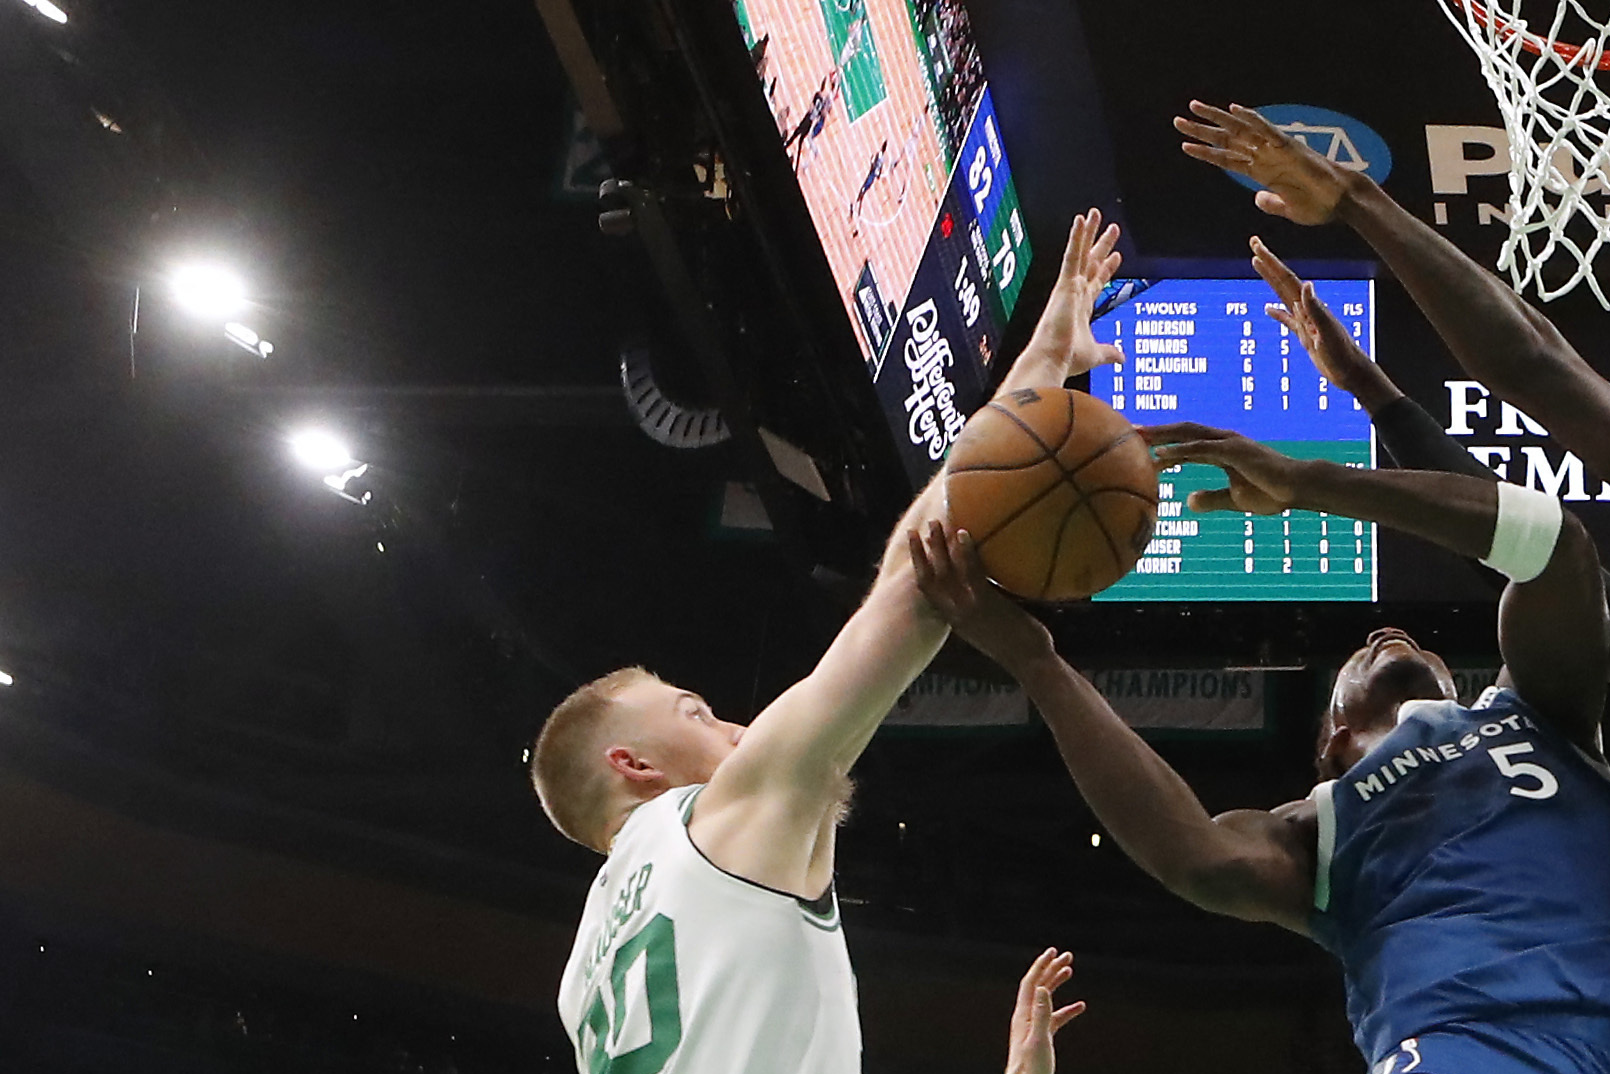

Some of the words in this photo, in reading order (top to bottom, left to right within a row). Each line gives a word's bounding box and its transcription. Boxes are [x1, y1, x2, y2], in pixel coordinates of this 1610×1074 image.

[1135, 303, 1197, 315] T-WOLVES
[1226, 304, 1248, 315] PTS
[1343, 304, 1363, 316] FLS
[1115, 321, 1121, 336] 1
[1135, 321, 1195, 336] ANDERSON
[1240, 340, 1255, 355] 22
[1282, 358, 1288, 373] 1
[1114, 377, 1123, 392] 11
[1135, 376, 1161, 391] REID
[1242, 377, 1254, 392] 16
[1319, 377, 1327, 392] 2
[1112, 395, 1125, 410] 18
[1135, 395, 1178, 410] MILTON
[1244, 395, 1252, 410] 2
[1282, 395, 1289, 410] 1
[1244, 521, 1253, 536] 3
[1284, 521, 1290, 536] 1
[1321, 521, 1327, 536] 1
[1143, 539, 1181, 555] AUSER
[1284, 539, 1290, 555] 1
[1356, 539, 1362, 555] 1
[1283, 557, 1291, 573] 2
[1488, 742, 1559, 800] 5
